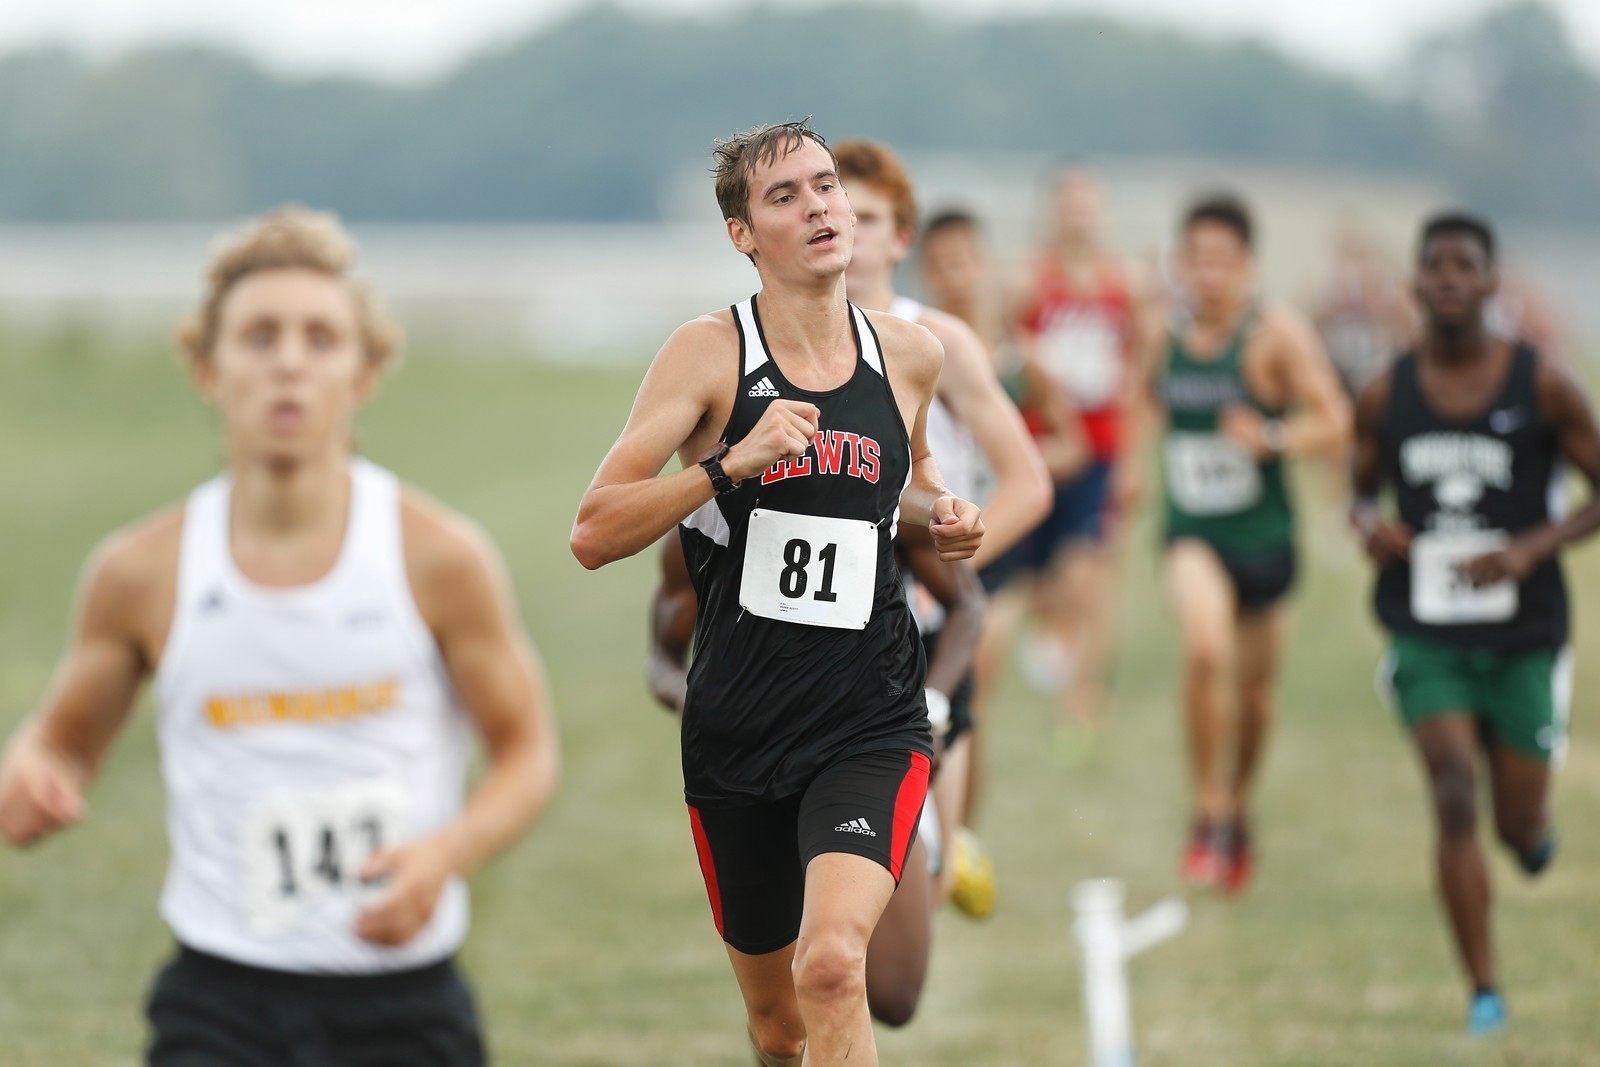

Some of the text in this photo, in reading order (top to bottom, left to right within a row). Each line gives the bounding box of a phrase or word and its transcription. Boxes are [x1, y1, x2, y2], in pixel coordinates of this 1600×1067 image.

[748, 388, 780, 397] adidas
[779, 538, 837, 602] 81
[834, 825, 877, 837] adidas
